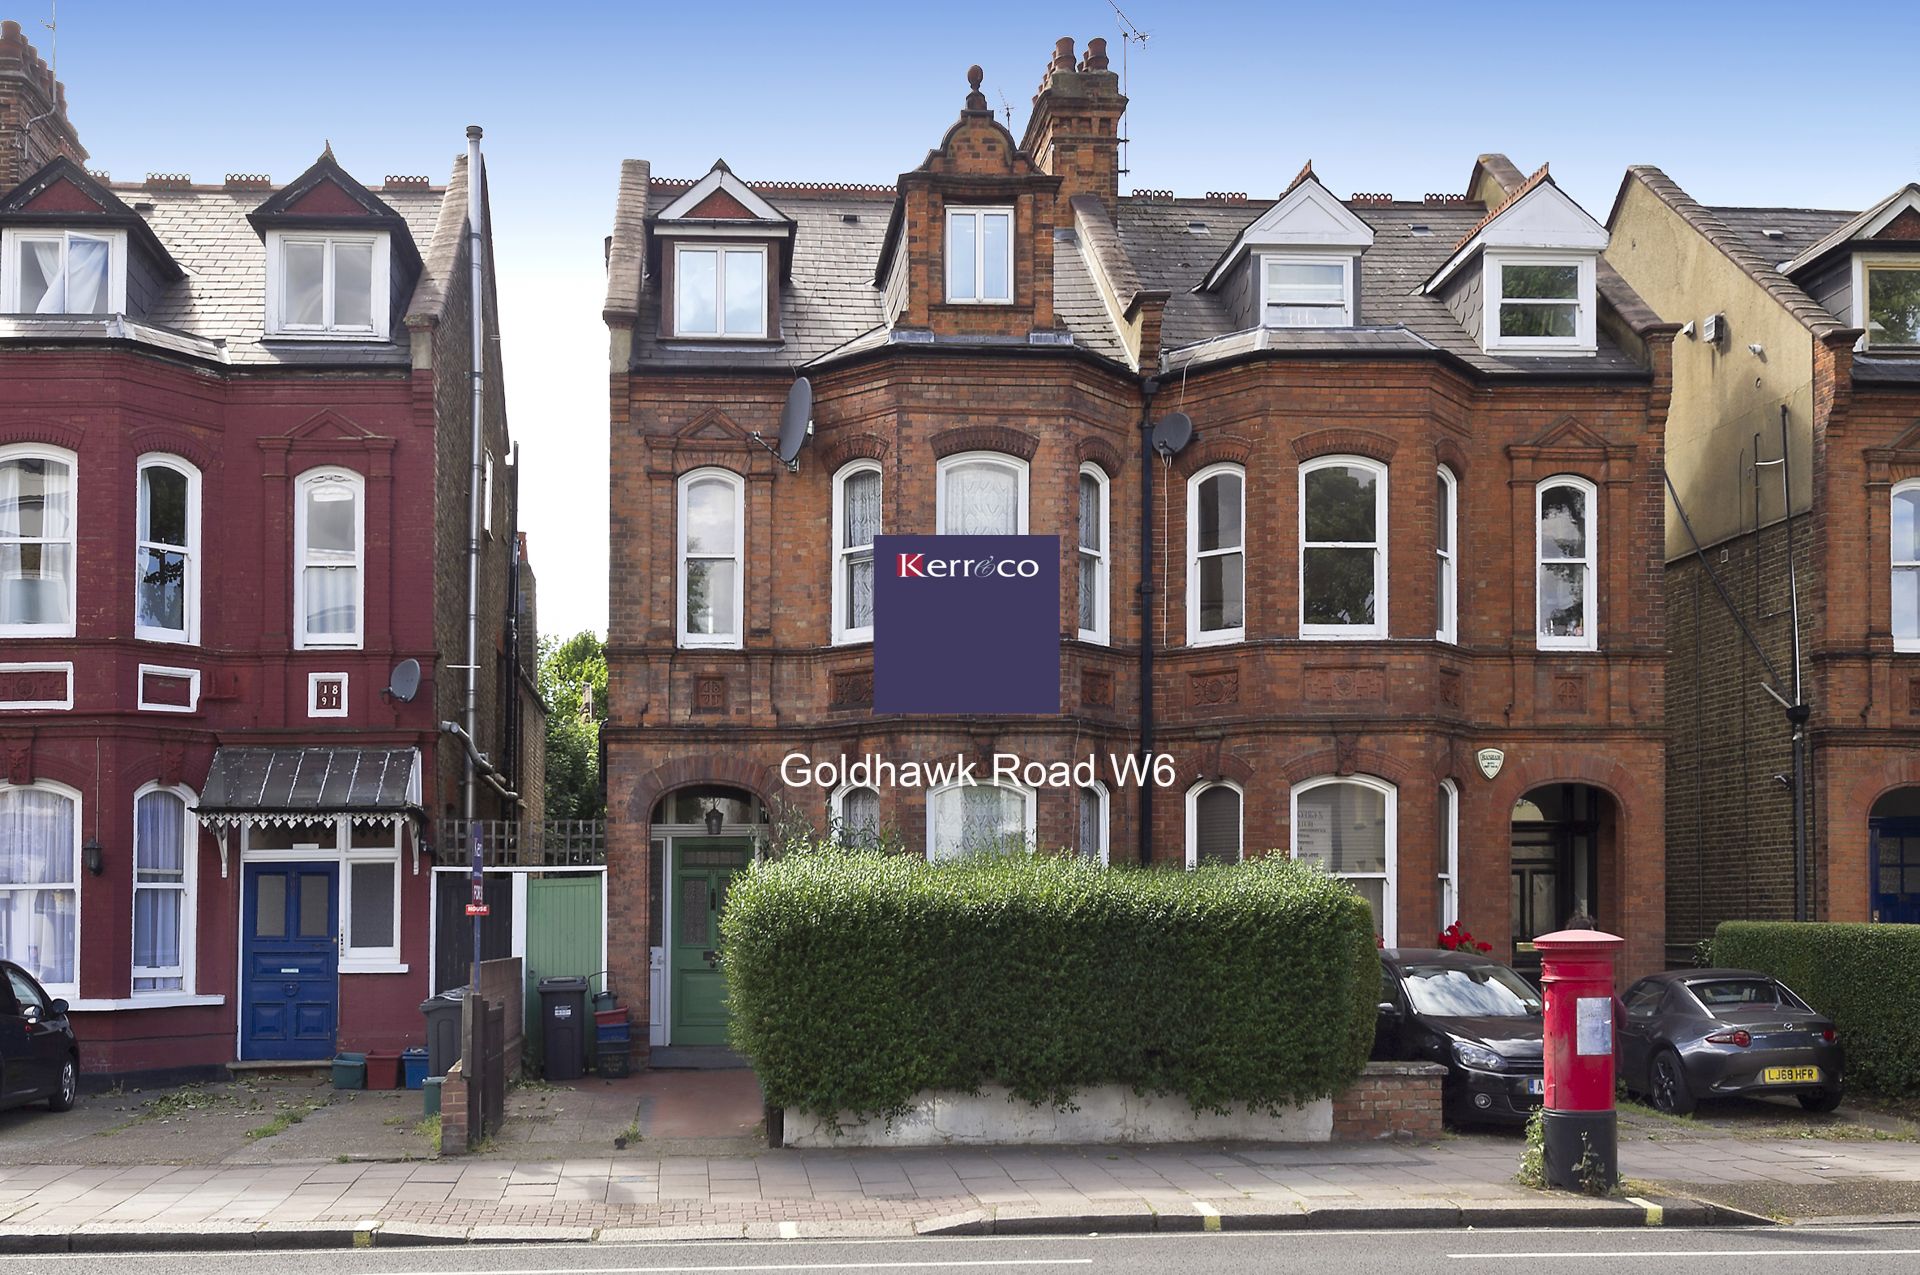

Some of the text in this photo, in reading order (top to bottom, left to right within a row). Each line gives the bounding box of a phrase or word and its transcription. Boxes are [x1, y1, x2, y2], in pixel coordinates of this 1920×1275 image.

[323, 684, 338, 695] 18
[321, 696, 336, 706] 91
[1768, 1069, 1814, 1080] LJ68 HFR
